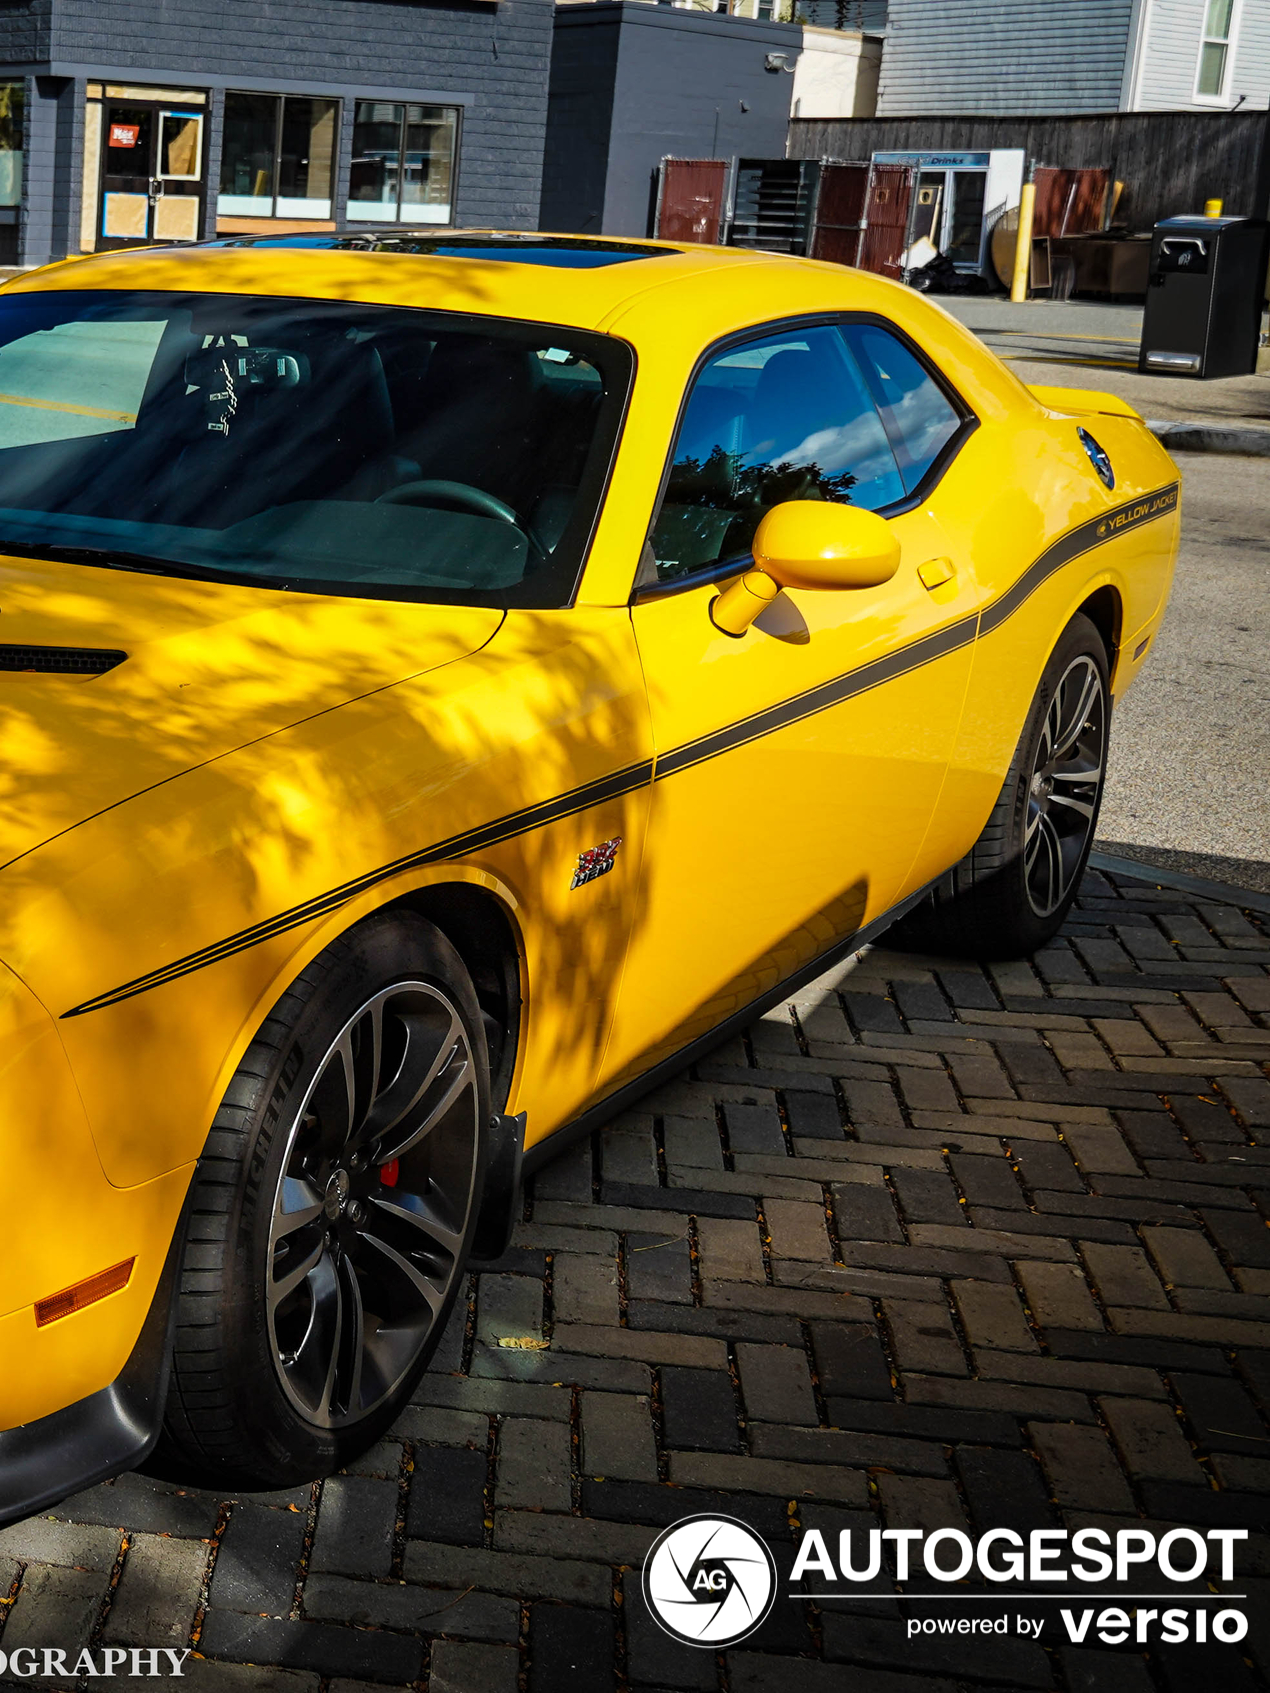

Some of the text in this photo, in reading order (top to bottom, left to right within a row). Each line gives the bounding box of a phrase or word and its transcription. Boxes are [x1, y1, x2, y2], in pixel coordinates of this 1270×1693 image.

[898, 156, 930, 166] Cold
[1108, 492, 1178, 530] YELLOW JACKET
[570, 858, 615, 890] HEMI
[241, 1053, 301, 1230] MICHELIN
